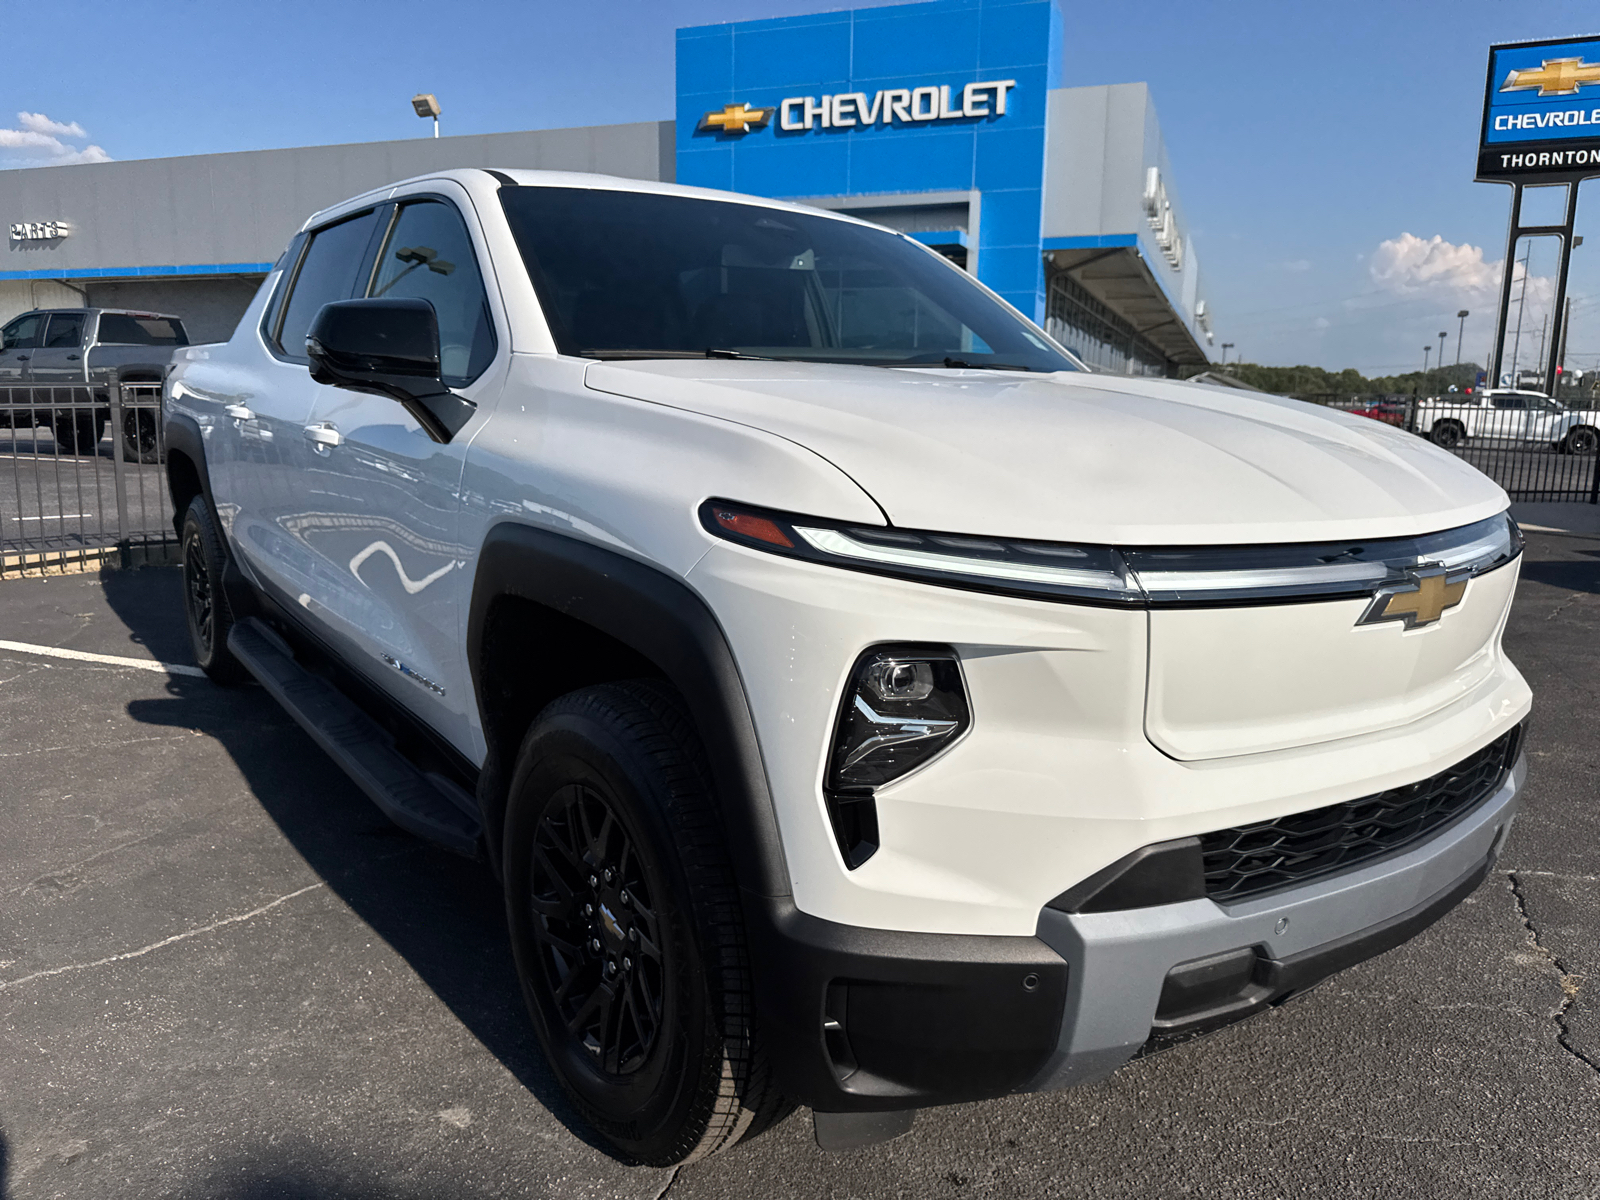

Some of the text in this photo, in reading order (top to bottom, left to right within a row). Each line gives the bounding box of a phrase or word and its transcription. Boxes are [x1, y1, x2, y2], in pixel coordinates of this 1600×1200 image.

[779, 79, 1016, 131] CHEVROLET
[1501, 150, 1600, 168] THORNTON
[10, 221, 63, 240] PARTS
